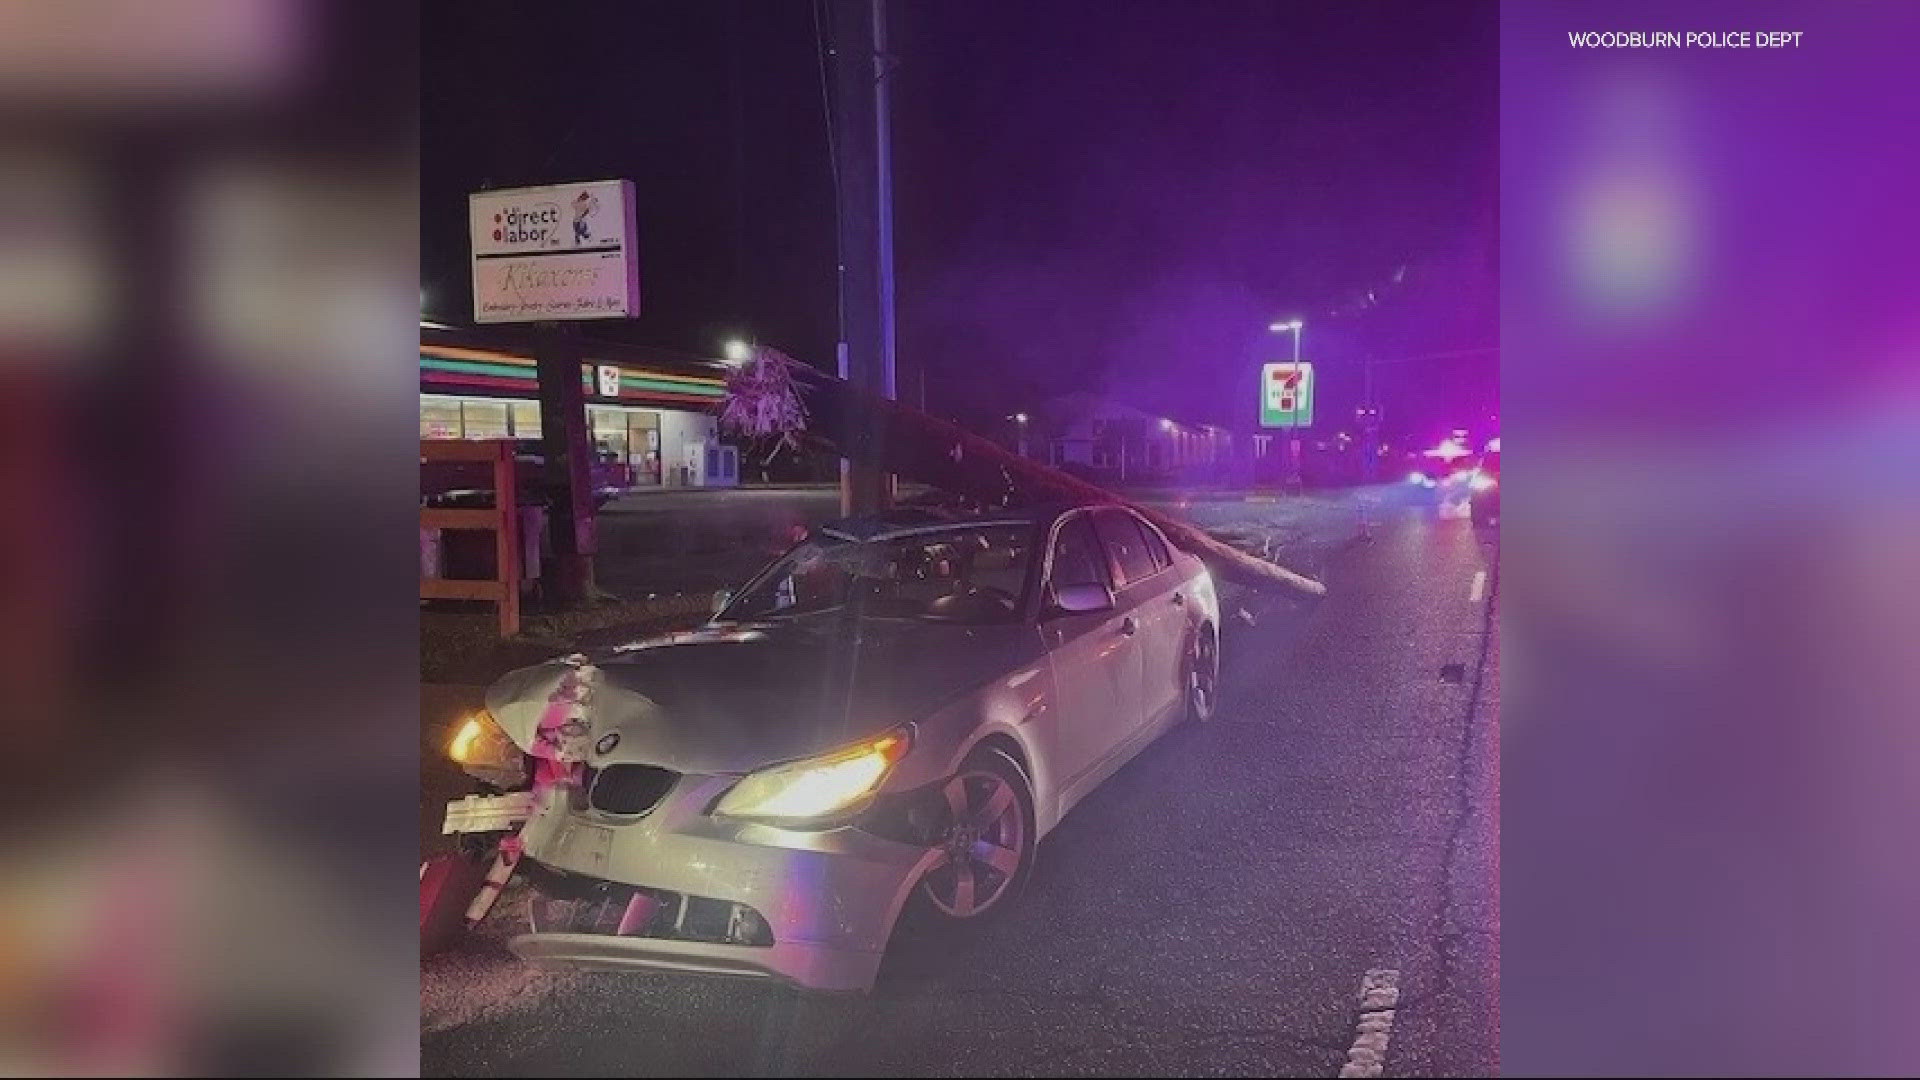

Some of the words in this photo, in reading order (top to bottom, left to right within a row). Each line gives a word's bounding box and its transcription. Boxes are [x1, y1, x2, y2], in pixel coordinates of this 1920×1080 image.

[507, 208, 558, 225] direct
[503, 224, 547, 243] labor
[1272, 370, 1303, 410] 7
